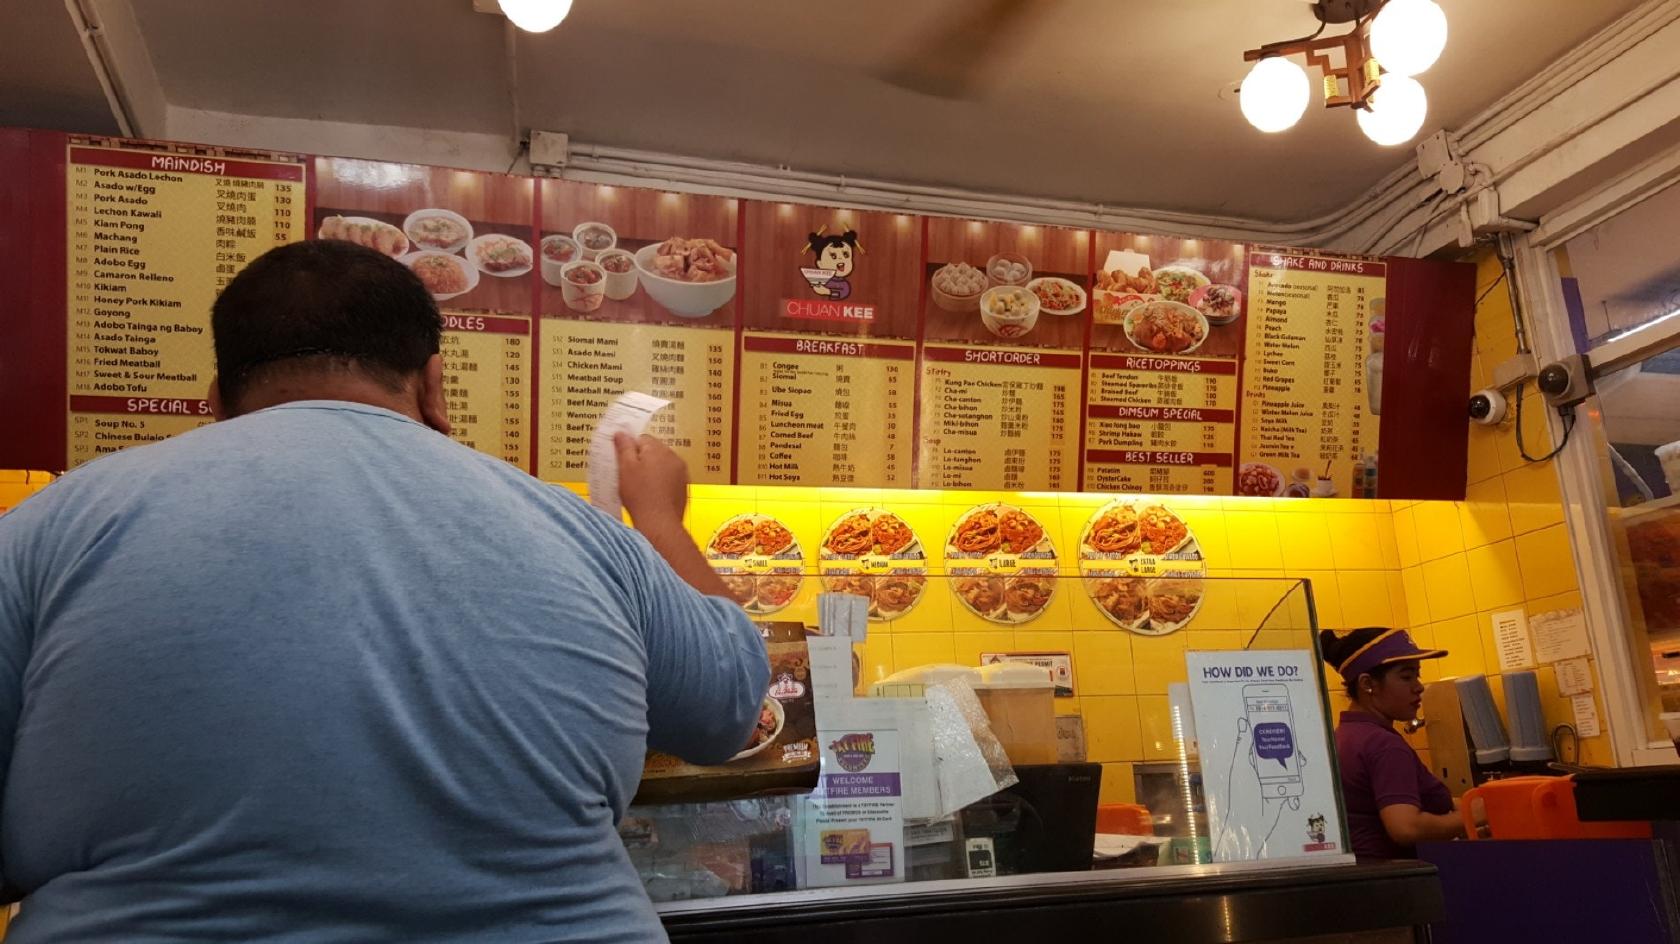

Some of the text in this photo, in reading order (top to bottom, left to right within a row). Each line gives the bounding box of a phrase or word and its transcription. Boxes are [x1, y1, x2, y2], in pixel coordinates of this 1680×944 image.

[94, 168, 183, 183] Pork Asado Lechon
[94, 181, 156, 195] Asado w/Egg
[275, 184, 292, 193] 135
[94, 194, 148, 205] Pork Asado
[274, 196, 292, 205] 130
[94, 206, 162, 219] Lechon Kawali
[274, 209, 291, 217] 110
[94, 219, 145, 232] Kiam Pong
[274, 221, 290, 230] 110
[94, 232, 138, 244] Machang
[275, 233, 287, 241] 55
[94, 244, 140, 255] Plain Rice
[94, 257, 146, 270] Adobo Egg
[1308, 259, 1328, 270] AND
[1330, 261, 1364, 273] DRINKS
[94, 270, 174, 282] Camaron Relleno
[94, 283, 127, 292] Kikiam
[94, 296, 182, 308] Honey Pork Kikiam
[786, 301, 873, 319] CHUAN KEE
[94, 321, 203, 335] Adobo Tainga ng Baboy
[441, 316, 485, 330] ODLES
[94, 333, 156, 344] Asado Tainga
[567, 336, 618, 346] Siomai Mami
[94, 345, 159, 357] Tokwat Baboy
[796, 340, 864, 355] BREAKFAST
[505, 351, 520, 359] 120
[567, 349, 616, 358] Asado Mami
[965, 350, 1041, 365] SHORTORDER
[94, 358, 161, 368] Fried Meatball
[505, 364, 520, 372] 145
[567, 361, 622, 371] Chicken Mami
[772, 361, 799, 370] Congee
[94, 370, 122, 379] Sweet
[133, 371, 155, 380] Sour
[156, 372, 197, 382] Meatball
[505, 377, 520, 385] 130
[567, 373, 624, 385] Meatball Soup
[93, 382, 147, 393] Adobo Tofu
[945, 380, 962, 388] Kung
[976, 380, 1002, 388] Chicken
[505, 390, 520, 398] 155
[567, 386, 601, 395] Meatball
[771, 386, 787, 394] Ube
[567, 399, 609, 408] Beef Mami
[790, 411, 804, 419] Egg
[95, 419, 138, 429] Soup No.
[566, 423, 584, 431] Beef
[770, 421, 805, 429] Luncheon
[95, 432, 132, 442] Chinese
[505, 430, 520, 438] 140
[770, 431, 796, 439] Corned
[565, 448, 584, 456] Beef
[1125, 452, 1194, 464] BEST SELLER
[565, 461, 584, 469] Beef
[1203, 665, 1298, 679] HOW DID WE DO?
[832, 776, 874, 785] WELCOME
[850, 786, 891, 794] MEMBERS
